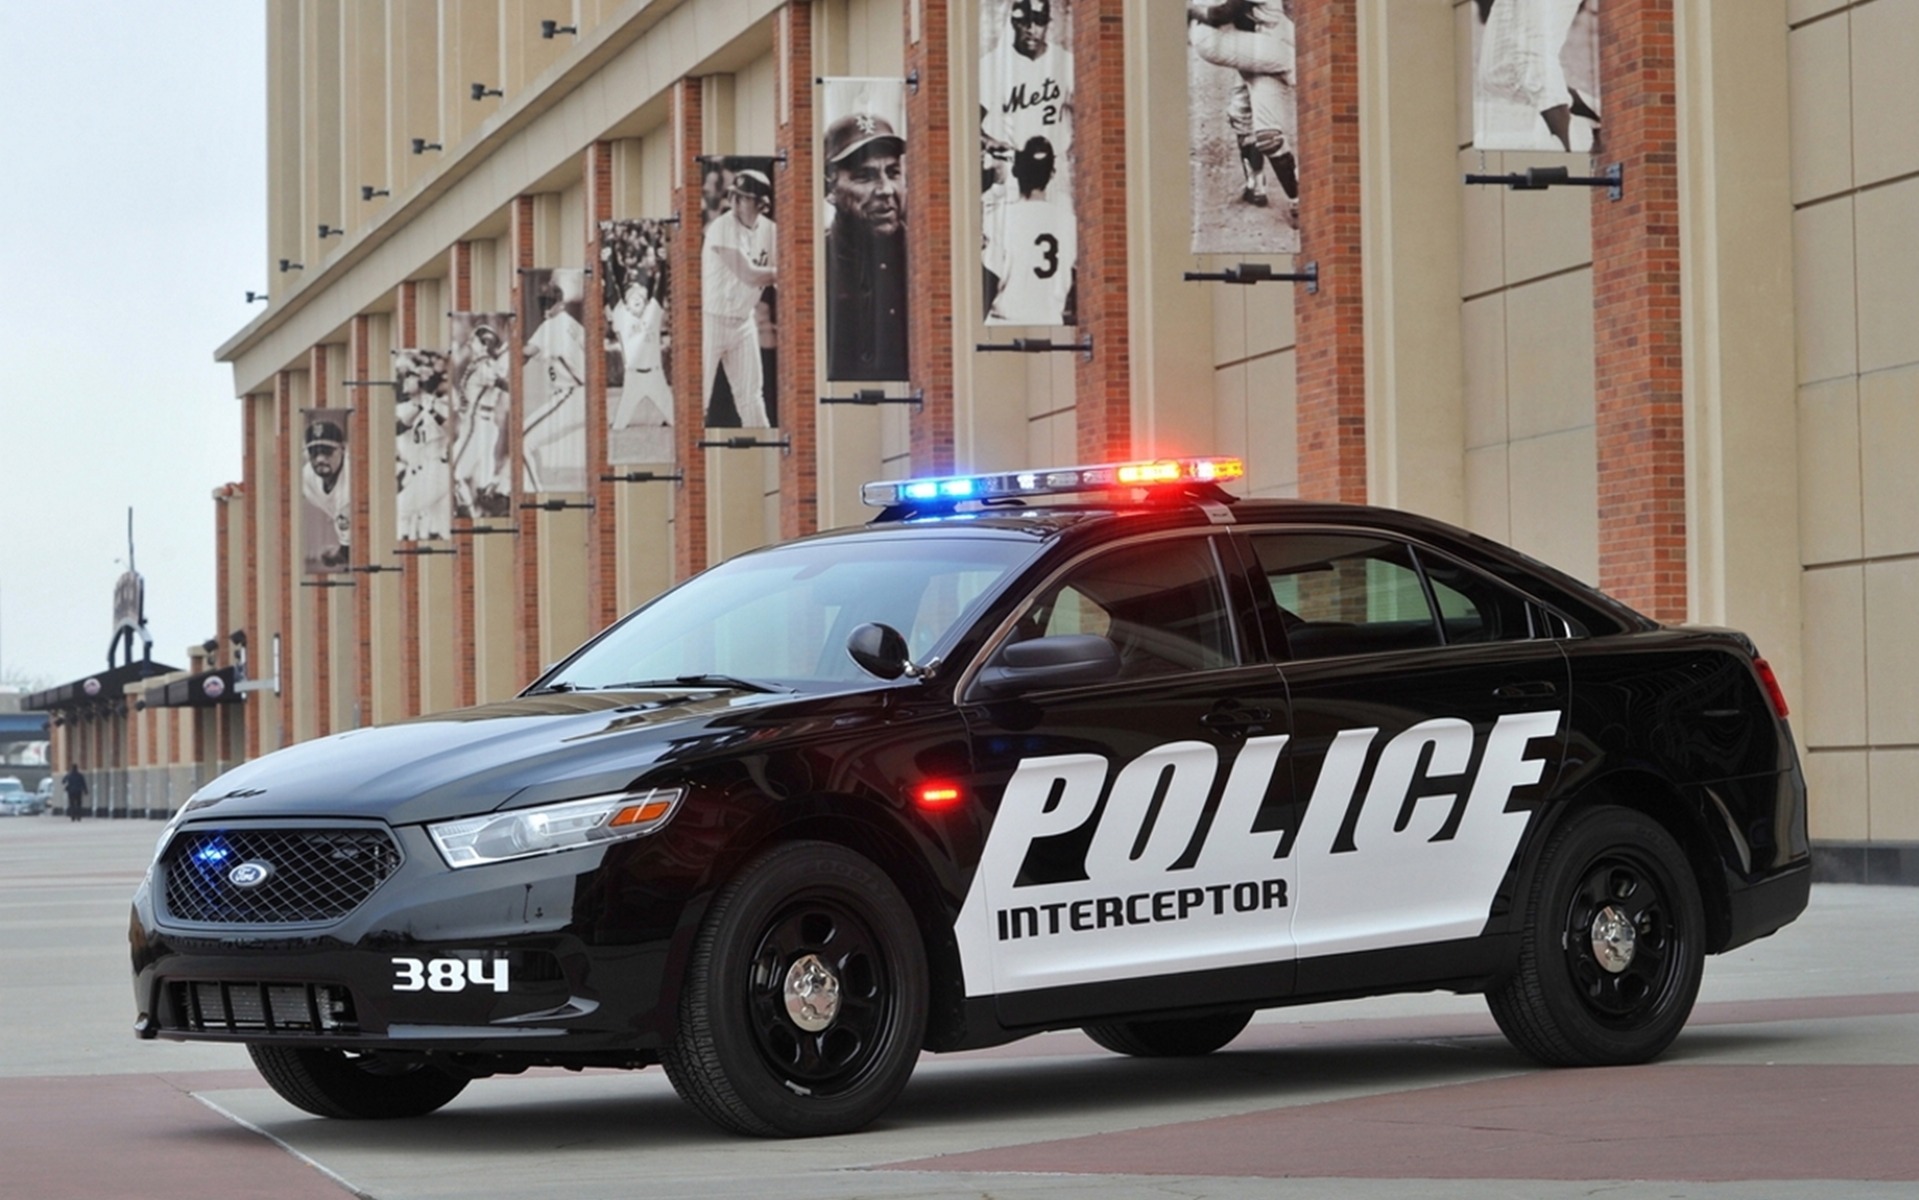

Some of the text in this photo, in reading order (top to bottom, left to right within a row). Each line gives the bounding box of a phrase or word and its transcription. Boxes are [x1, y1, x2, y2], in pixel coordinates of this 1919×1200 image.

[1002, 78, 1061, 113] Mets
[1033, 233, 1059, 280] 3
[986, 710, 1562, 888] POLICE
[997, 878, 1289, 942] INTERCEPTOR
[391, 957, 509, 992] 384
